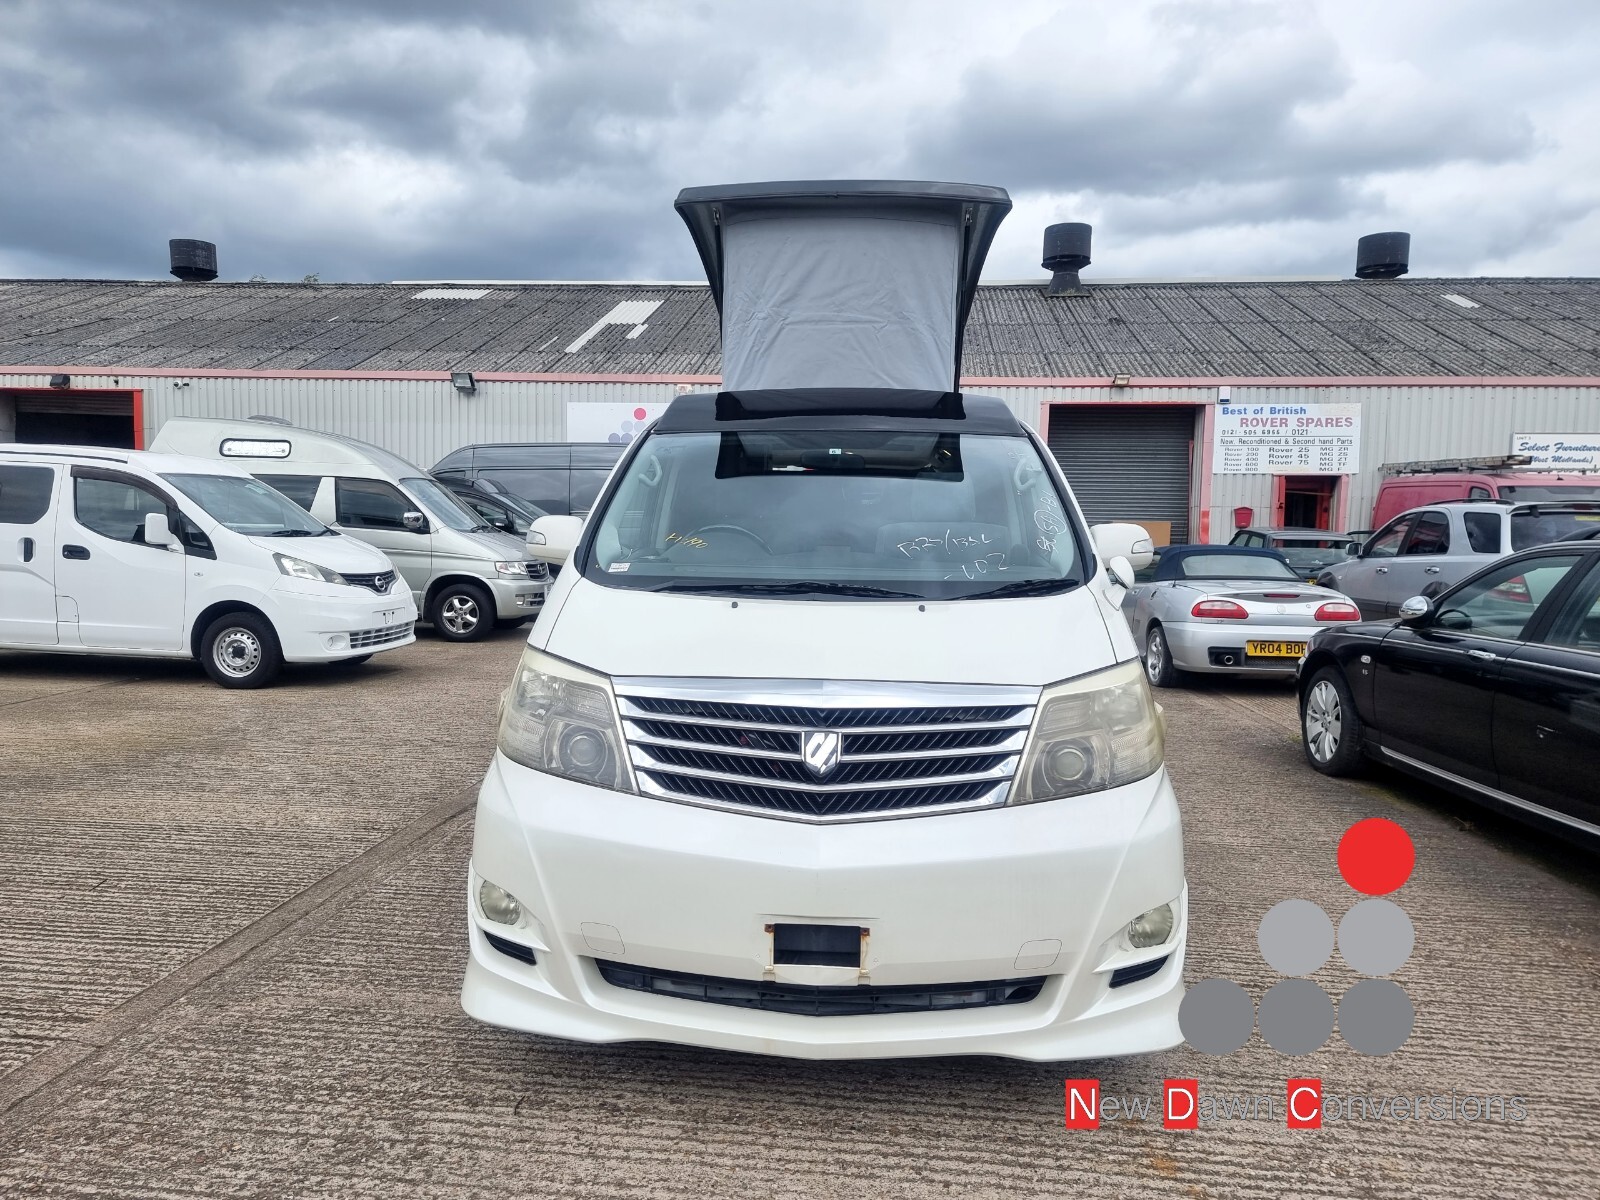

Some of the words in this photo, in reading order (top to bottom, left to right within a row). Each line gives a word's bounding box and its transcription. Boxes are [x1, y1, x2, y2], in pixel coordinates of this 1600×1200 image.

[1222, 407, 1247, 415] Best
[1253, 407, 1264, 415] of
[1269, 407, 1307, 415] British
[1240, 417, 1289, 428] ROVER
[1296, 417, 1353, 428] SPARES
[1518, 442, 1550, 452] Select
[1252, 643, 1282, 654] YR04
